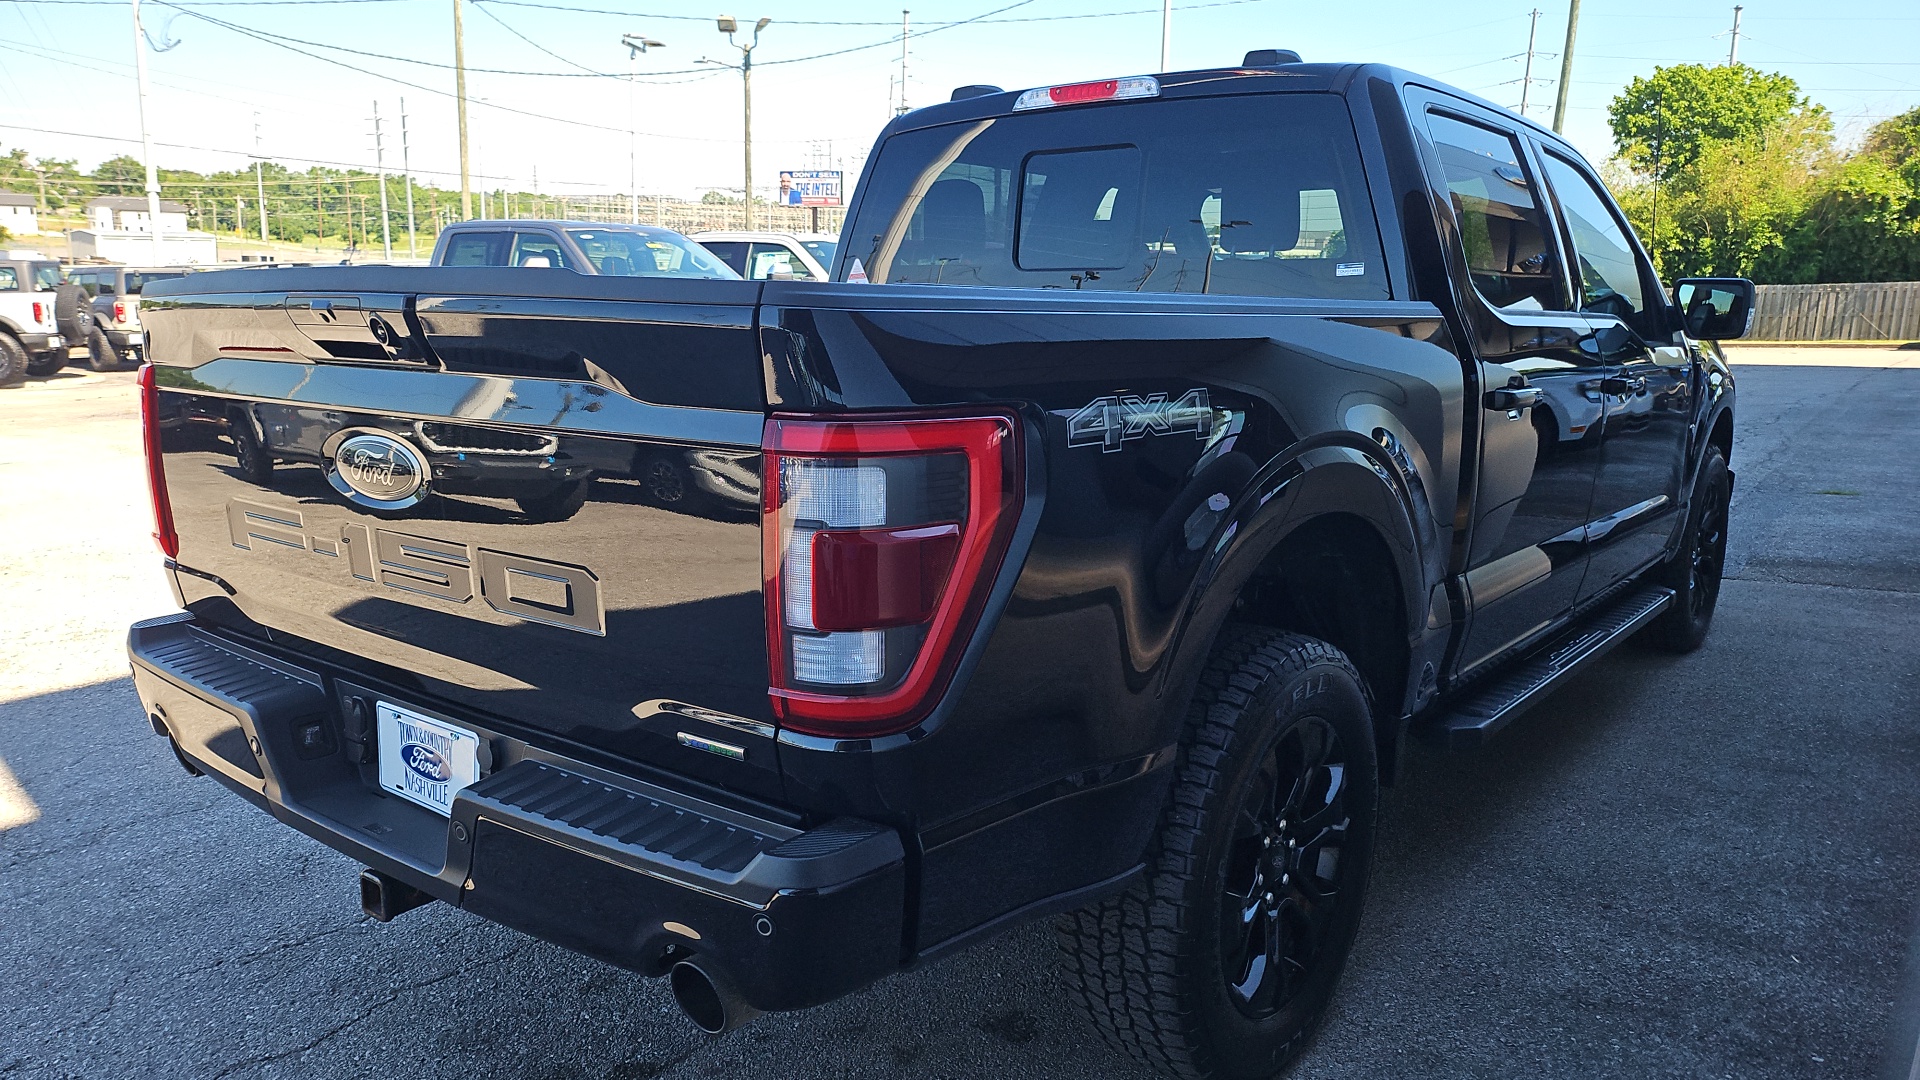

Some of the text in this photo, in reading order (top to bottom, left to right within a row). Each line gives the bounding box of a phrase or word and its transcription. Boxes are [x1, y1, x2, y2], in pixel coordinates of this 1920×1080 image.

[796, 182, 838, 196] THE INTEL!
[351, 448, 395, 487] Ford
[226, 498, 606, 637] F-150
[397, 720, 418, 745] TOWN
[424, 731, 452, 766] COUNTRY
[410, 746, 442, 779] Ford
[404, 766, 449, 806] NASHVILLE
